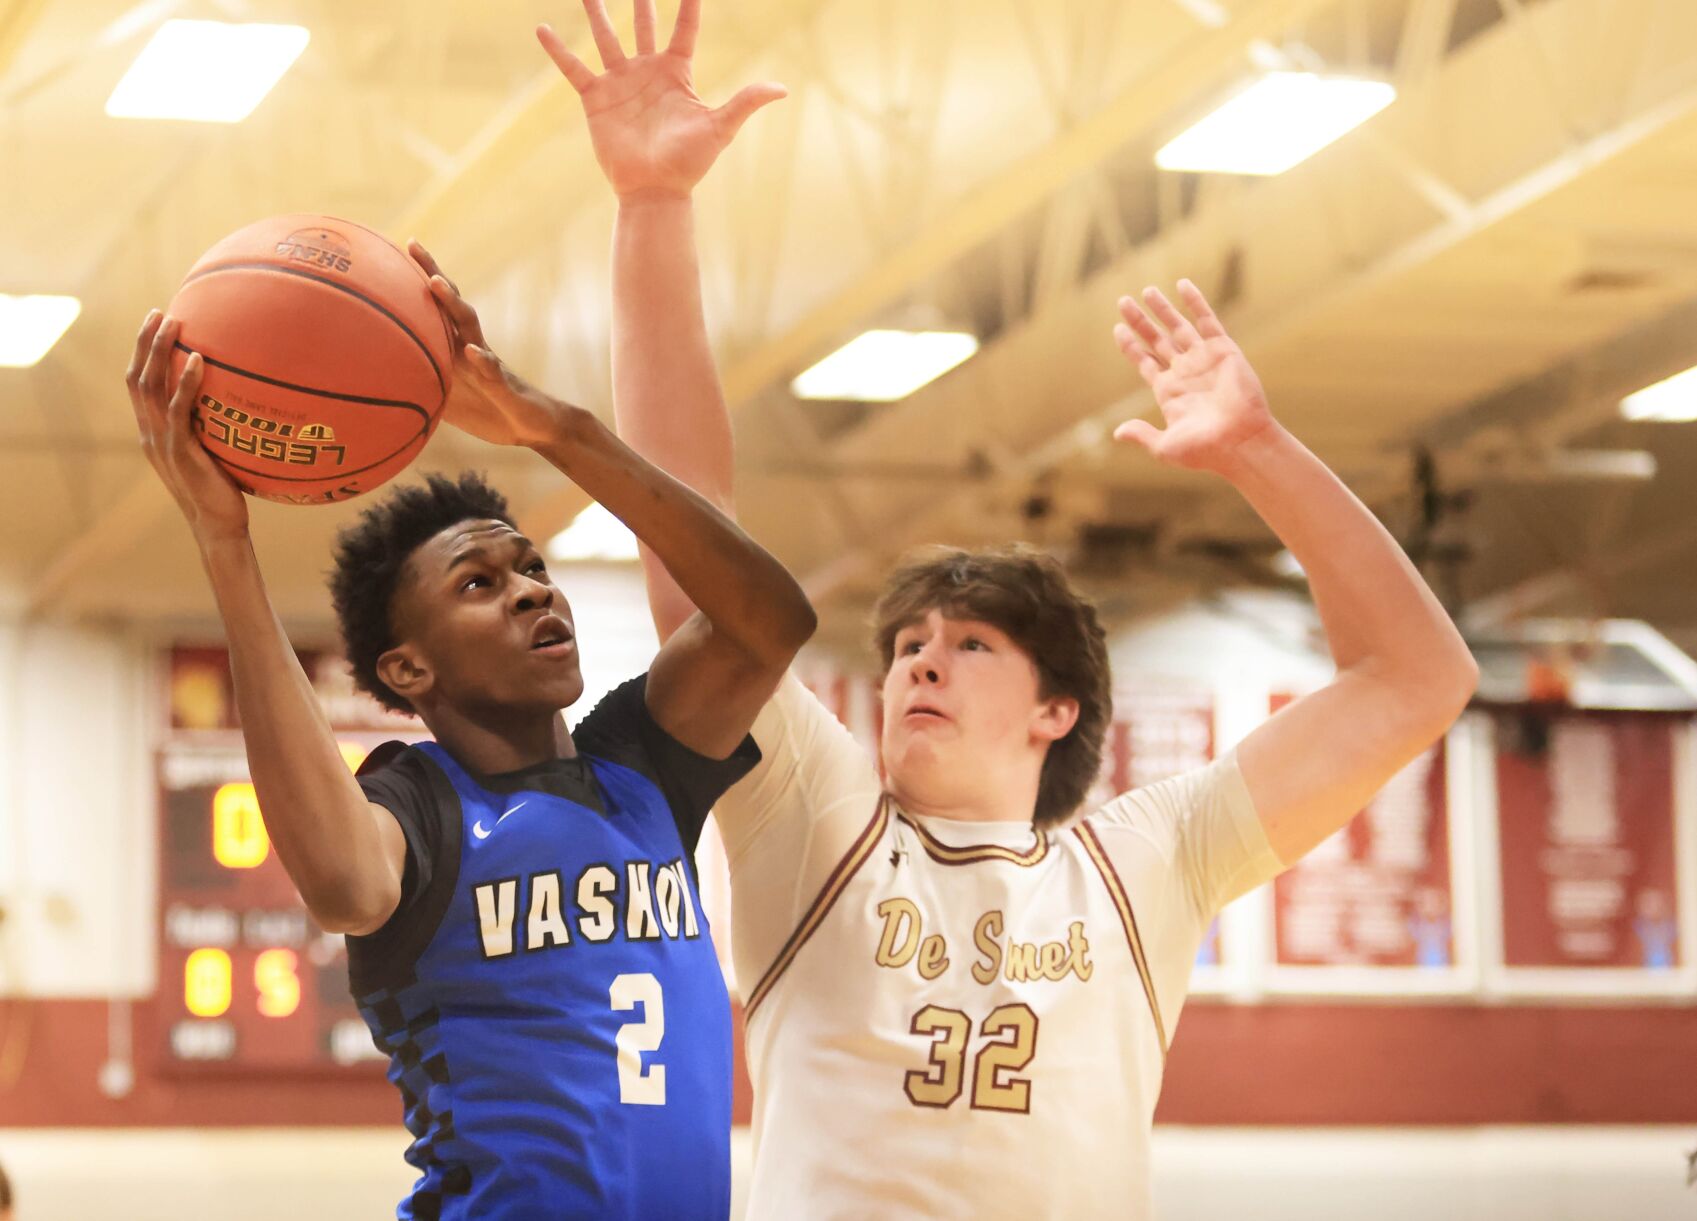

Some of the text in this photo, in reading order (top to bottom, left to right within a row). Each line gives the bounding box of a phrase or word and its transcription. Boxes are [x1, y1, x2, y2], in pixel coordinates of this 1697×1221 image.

[875, 897, 1094, 986] De Smet
[608, 972, 667, 1106] 2
[903, 1003, 1040, 1115] 32
